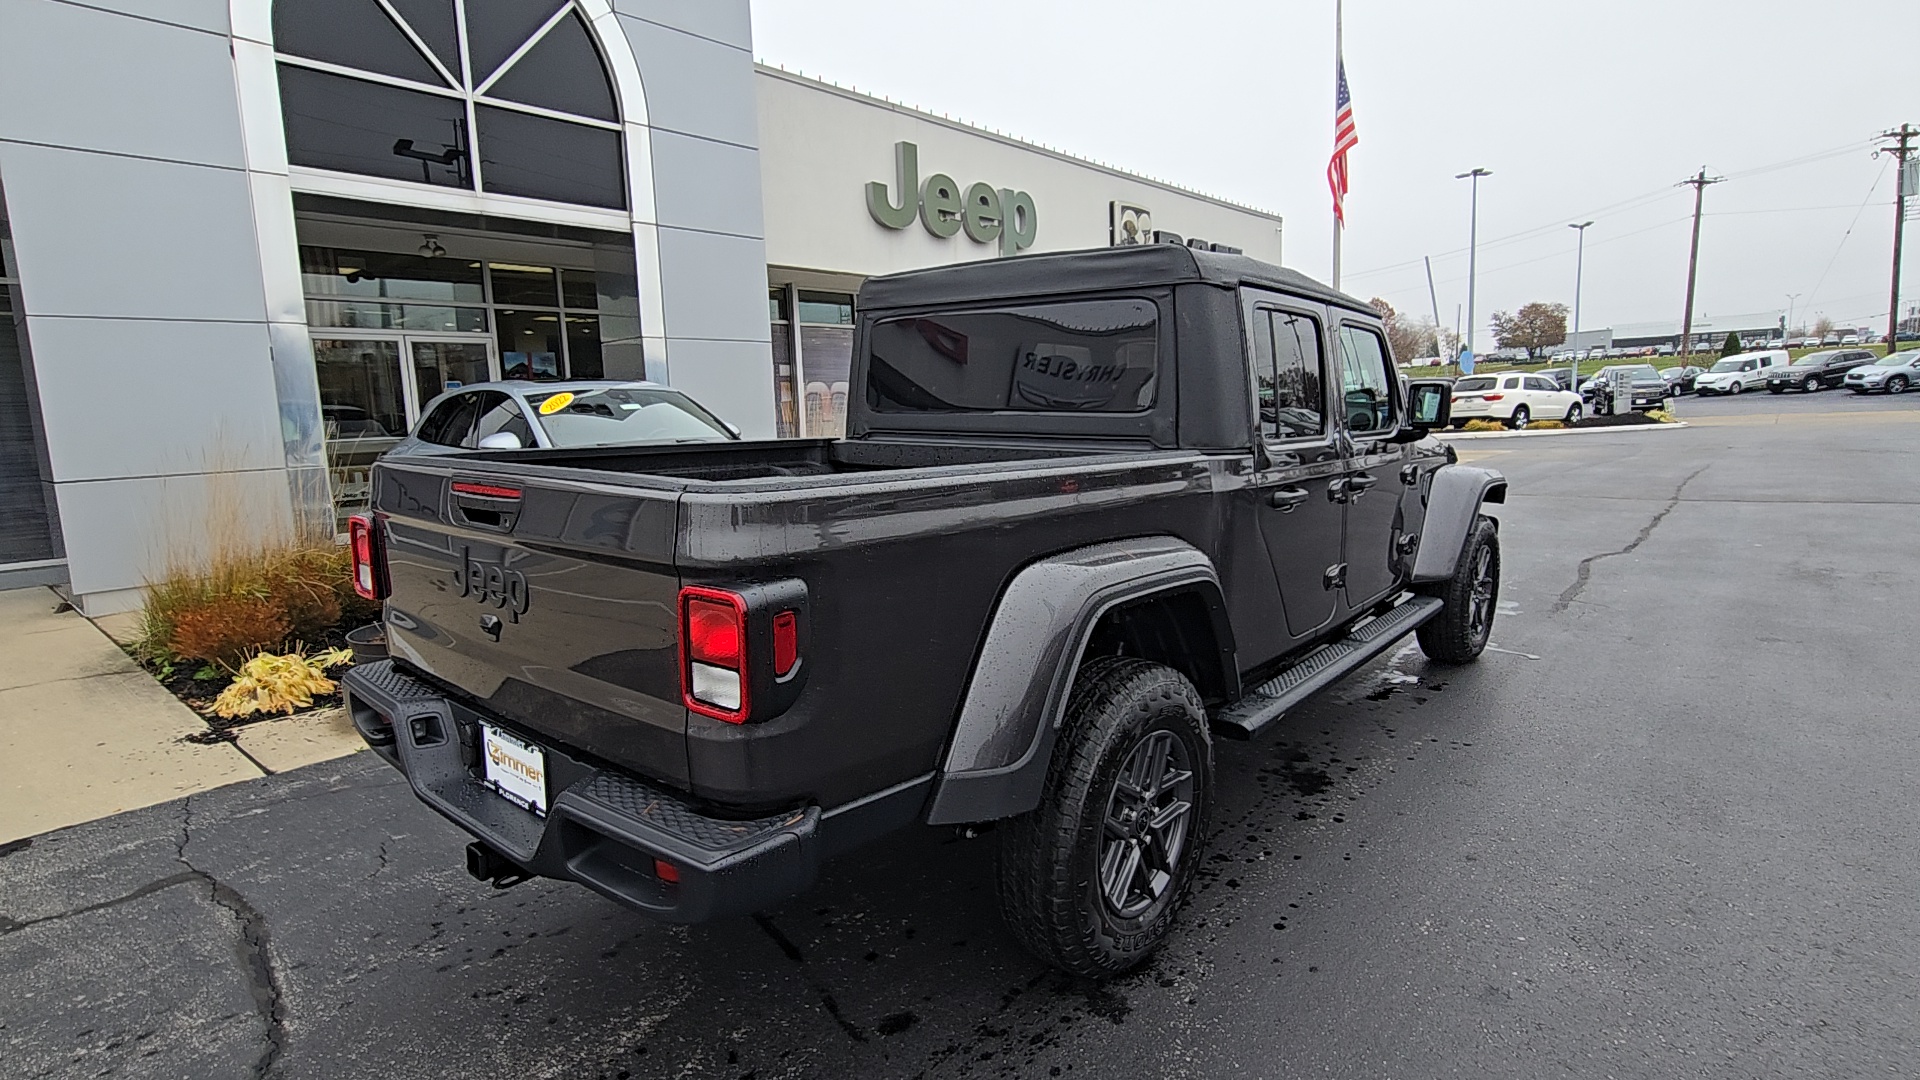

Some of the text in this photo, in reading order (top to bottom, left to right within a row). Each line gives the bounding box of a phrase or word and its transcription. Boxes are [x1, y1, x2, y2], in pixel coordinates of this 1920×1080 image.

[865, 141, 1037, 257] Jeep
[546, 395, 569, 411] 2022
[454, 545, 529, 624] Jeep
[489, 742, 543, 783] Zimmer
